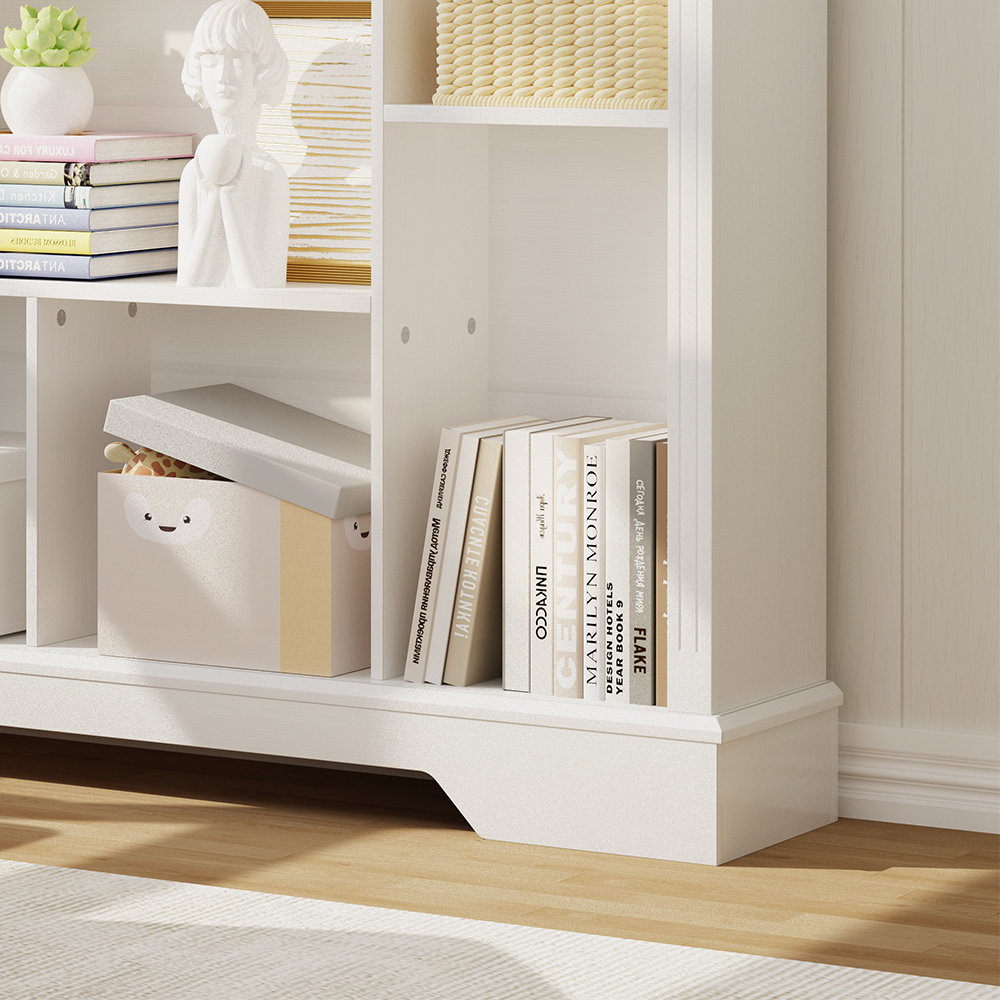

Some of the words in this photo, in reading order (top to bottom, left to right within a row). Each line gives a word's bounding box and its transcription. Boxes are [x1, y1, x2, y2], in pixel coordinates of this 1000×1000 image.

[586, 454, 598, 563] MONROE
[634, 479, 646, 516] СЕГОДНЯ
[633, 519, 646, 543] ДЕНЬ
[555, 448, 577, 690] CENTURY
[634, 545, 645, 588] РОЖДЕНИЯ
[616, 599, 624, 609] 9
[635, 590, 645, 614] МИРА
[586, 571, 598, 686] MARILYN
[616, 612, 624, 653] BOOK
[633, 626, 647, 675] FLAKE
[616, 658, 624, 696] YEAR
